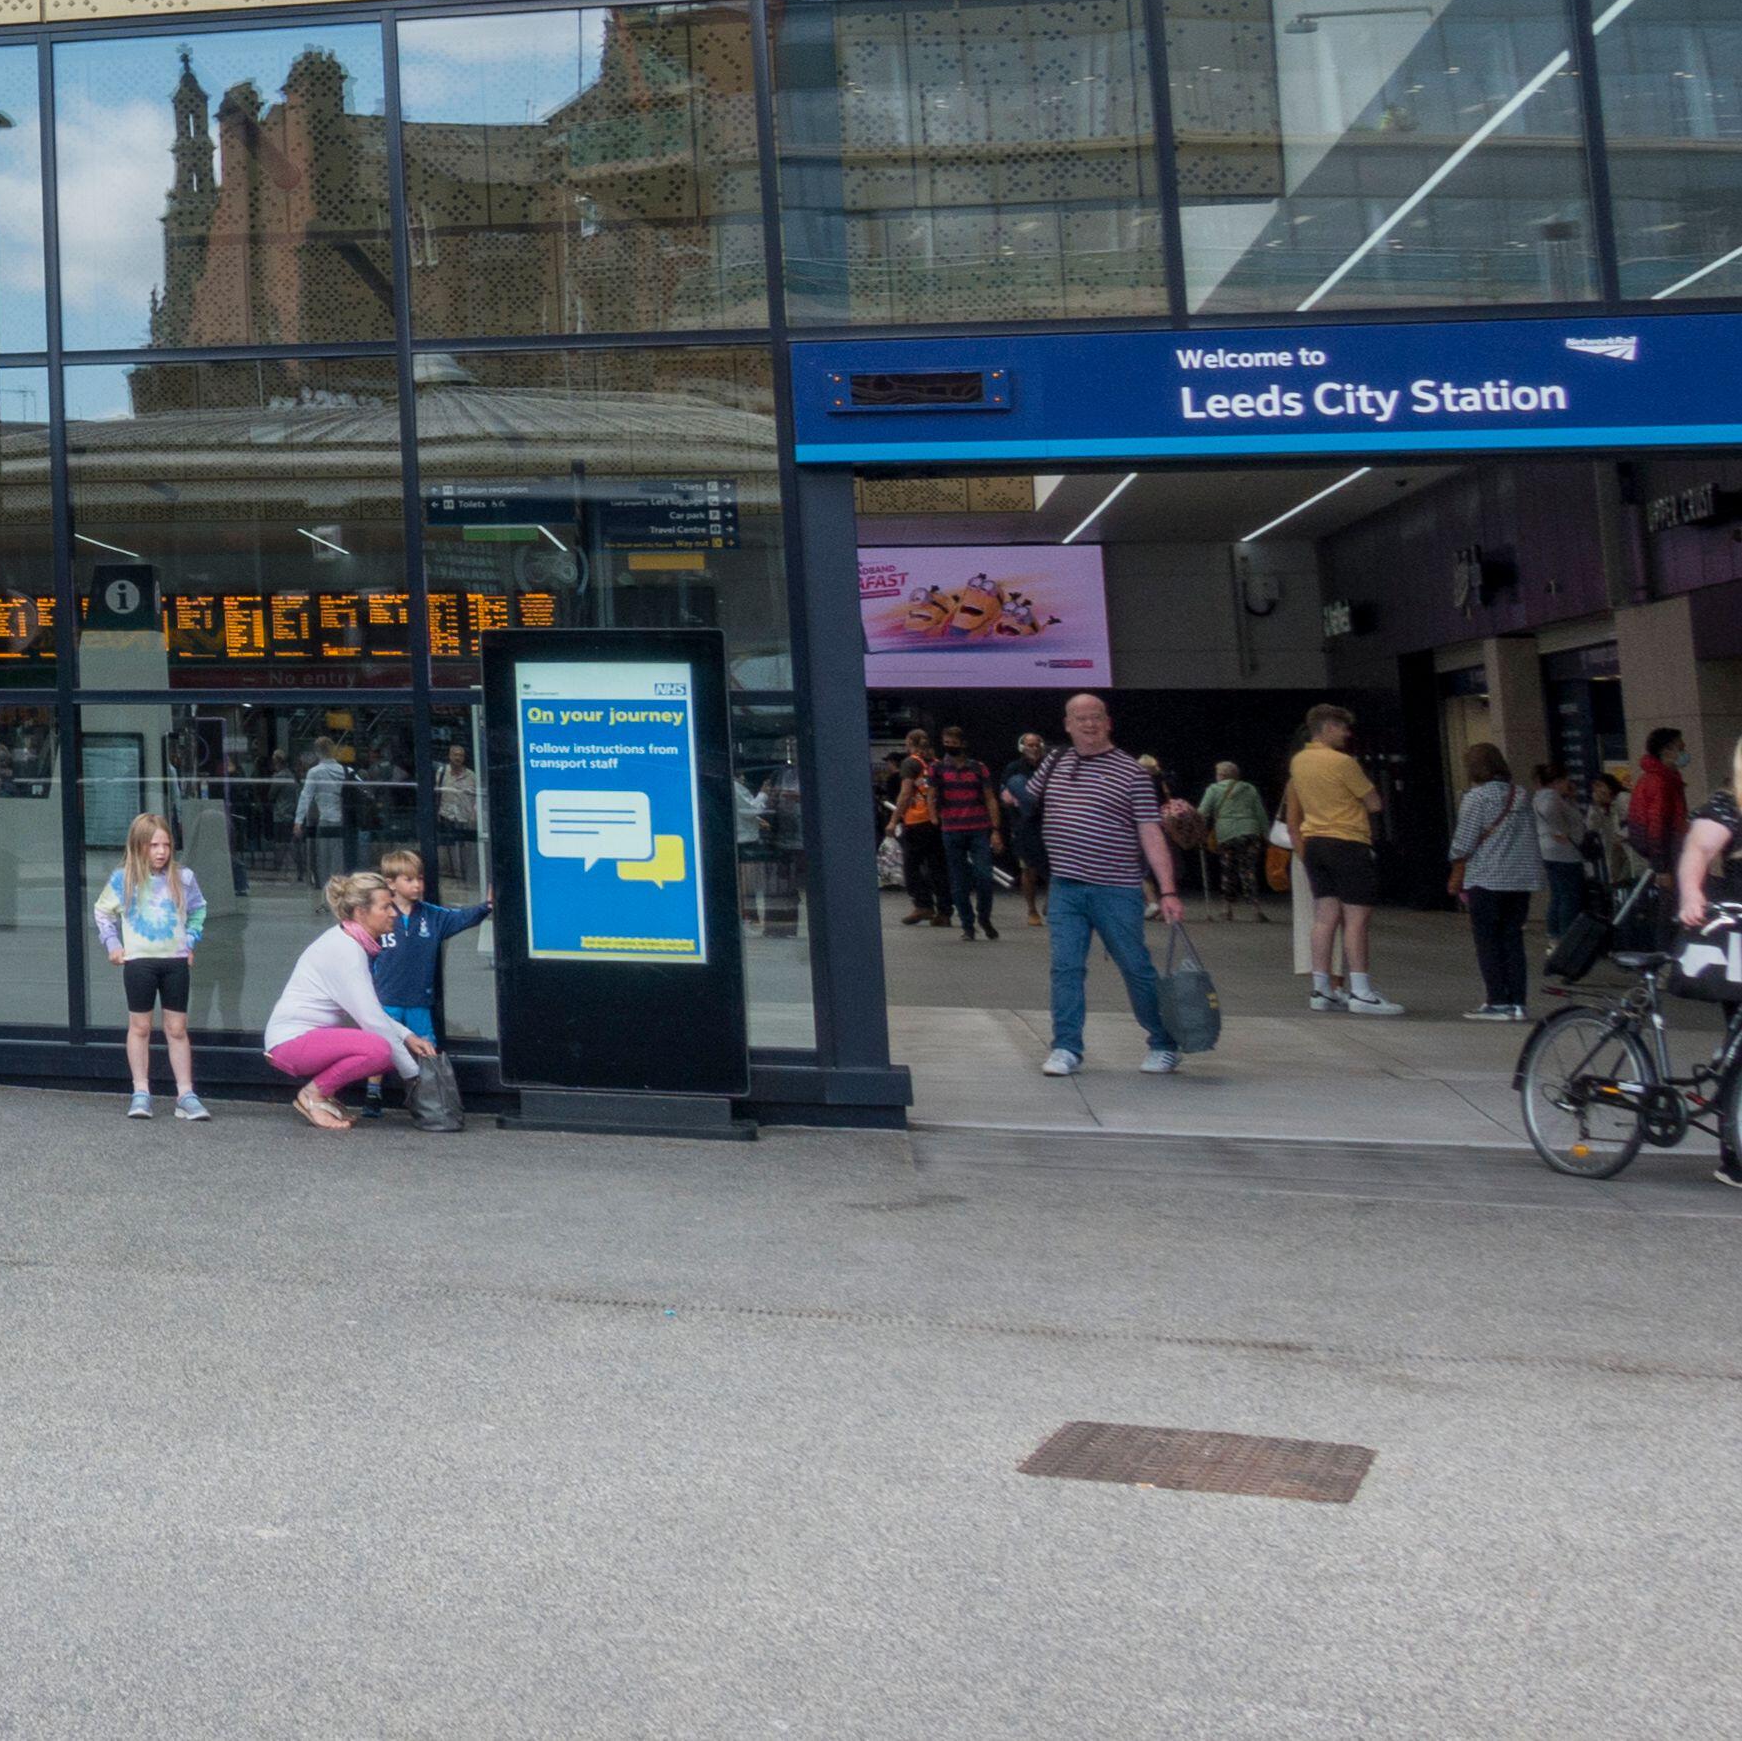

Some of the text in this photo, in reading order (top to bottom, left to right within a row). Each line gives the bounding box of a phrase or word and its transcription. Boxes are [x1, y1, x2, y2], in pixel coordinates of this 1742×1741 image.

[1176, 347, 1326, 370] Welcome to
[1181, 379, 1568, 422] Leeds City Station
[457, 485, 487, 495] Station
[672, 482, 704, 492] Tickets
[458, 499, 487, 509] Toilets
[669, 510, 685, 520] Car
[686, 510, 706, 522] park
[650, 524, 706, 535] Travel Centre
[269, 672, 358, 688] No entry
[655, 683, 686, 695] NHS
[527, 707, 685, 727] On your journey
[529, 742, 679, 755] Follow instructions from
[530, 758, 619, 771] transport staff
